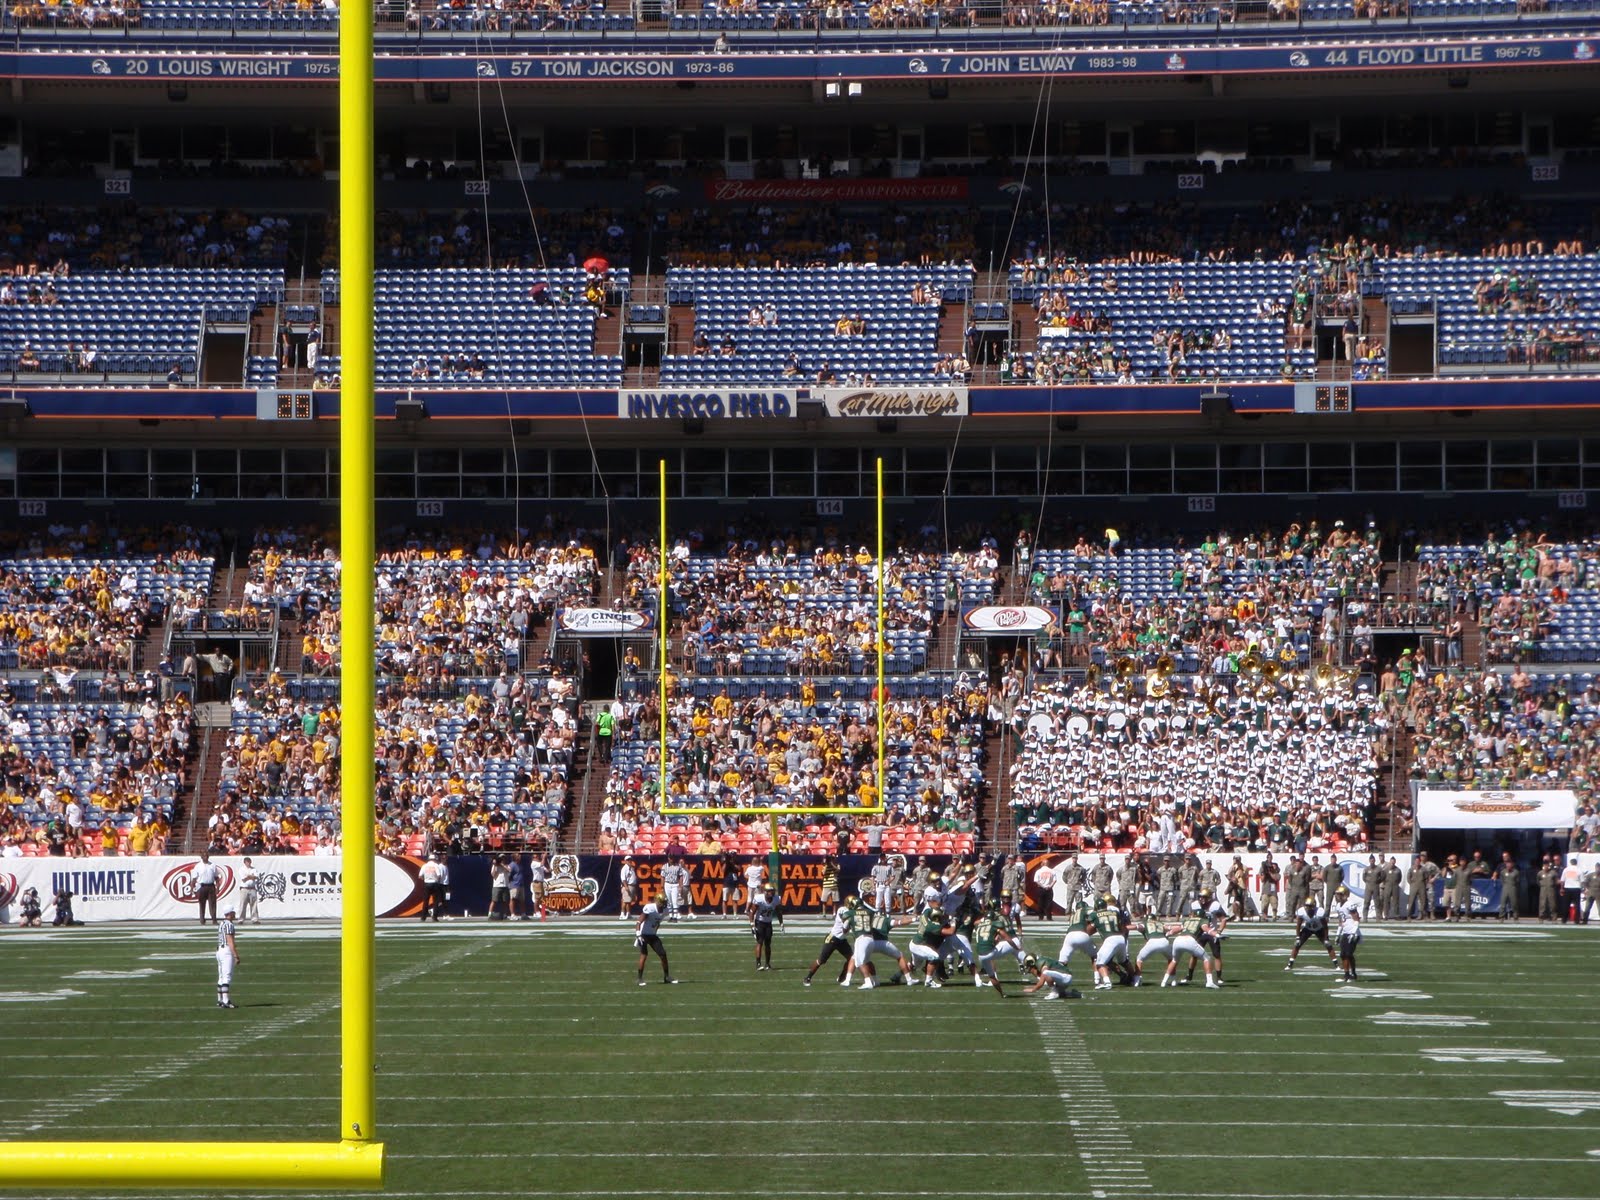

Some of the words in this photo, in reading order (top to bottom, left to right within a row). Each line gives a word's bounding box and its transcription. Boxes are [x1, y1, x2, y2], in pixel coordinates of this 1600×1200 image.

[1324, 51, 1348, 65] 44
[1358, 49, 1415, 65] FLOYD
[1423, 46, 1482, 63] LITTLE
[1494, 46, 1541, 59] 1967-75
[126, 60, 148, 75] 20
[158, 60, 213, 75] LOUIS
[219, 60, 292, 76] WRIGHT
[304, 63, 340, 74] 1975-
[511, 61, 532, 76] 57
[541, 61, 582, 76] TOM
[587, 61, 674, 76] JACKSON
[685, 62, 734, 74] 1973-86
[941, 58, 951, 73] 7
[959, 57, 1010, 73] JOHN
[1018, 56, 1077, 72] ELWAY
[1088, 57, 1137, 69] 1983-98
[105, 180, 129, 193] 321
[465, 181, 489, 194] 322
[1179, 175, 1202, 188] 324
[714, 180, 834, 200] Budweiser
[836, 184, 918, 197] CHAMPIONS
[921, 184, 959, 196] CLUB
[627, 393, 725, 417] INVESCO
[729, 393, 791, 417] FIELD
[846, 397, 865, 413] at
[865, 390, 912, 415] Mile
[914, 390, 959, 415] High
[1316, 387, 1348, 410] 25
[278, 394, 309, 418] 25
[21, 502, 44, 514] 112
[418, 502, 441, 514] 113
[818, 501, 841, 513] 114
[1189, 498, 1213, 510] 115
[591, 612, 631, 621] CINCH
[1464, 804, 1531, 812] SHOWDOWN
[52, 870, 136, 895] ULTIMATE
[291, 871, 343, 886] CIN
[293, 888, 324, 896] JEANS
[541, 896, 588, 910] SHOWDOWN
